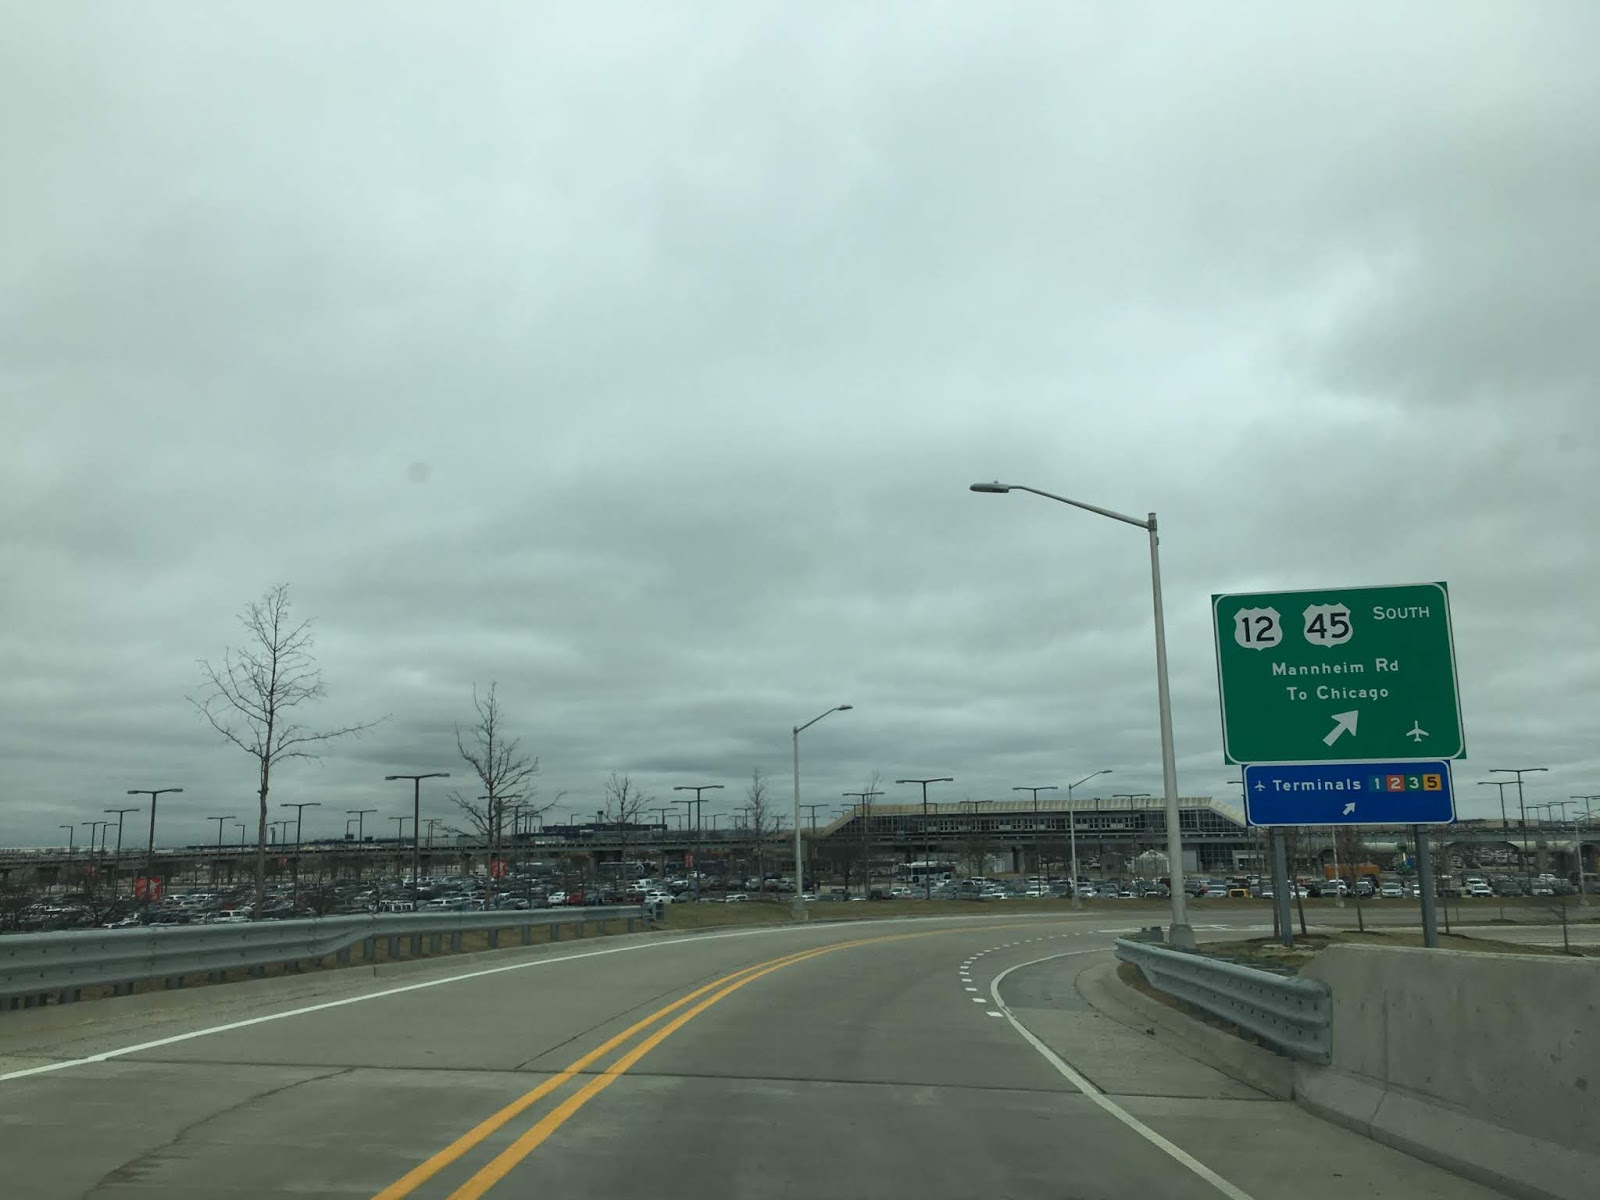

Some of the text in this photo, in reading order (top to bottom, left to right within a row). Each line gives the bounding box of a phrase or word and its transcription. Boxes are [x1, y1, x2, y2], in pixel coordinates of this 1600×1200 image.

[1372, 606, 1430, 620] SOUTH
[1242, 616, 1275, 643] 12
[1306, 611, 1350, 640] 45
[1272, 658, 1399, 676] Mannheim Rd
[1286, 685, 1389, 702] To Chicago
[1272, 778, 1362, 792] Terminals
[1390, 777, 1402, 790] 2
[1409, 777, 1420, 790] 3
[1427, 776, 1438, 789] 5
